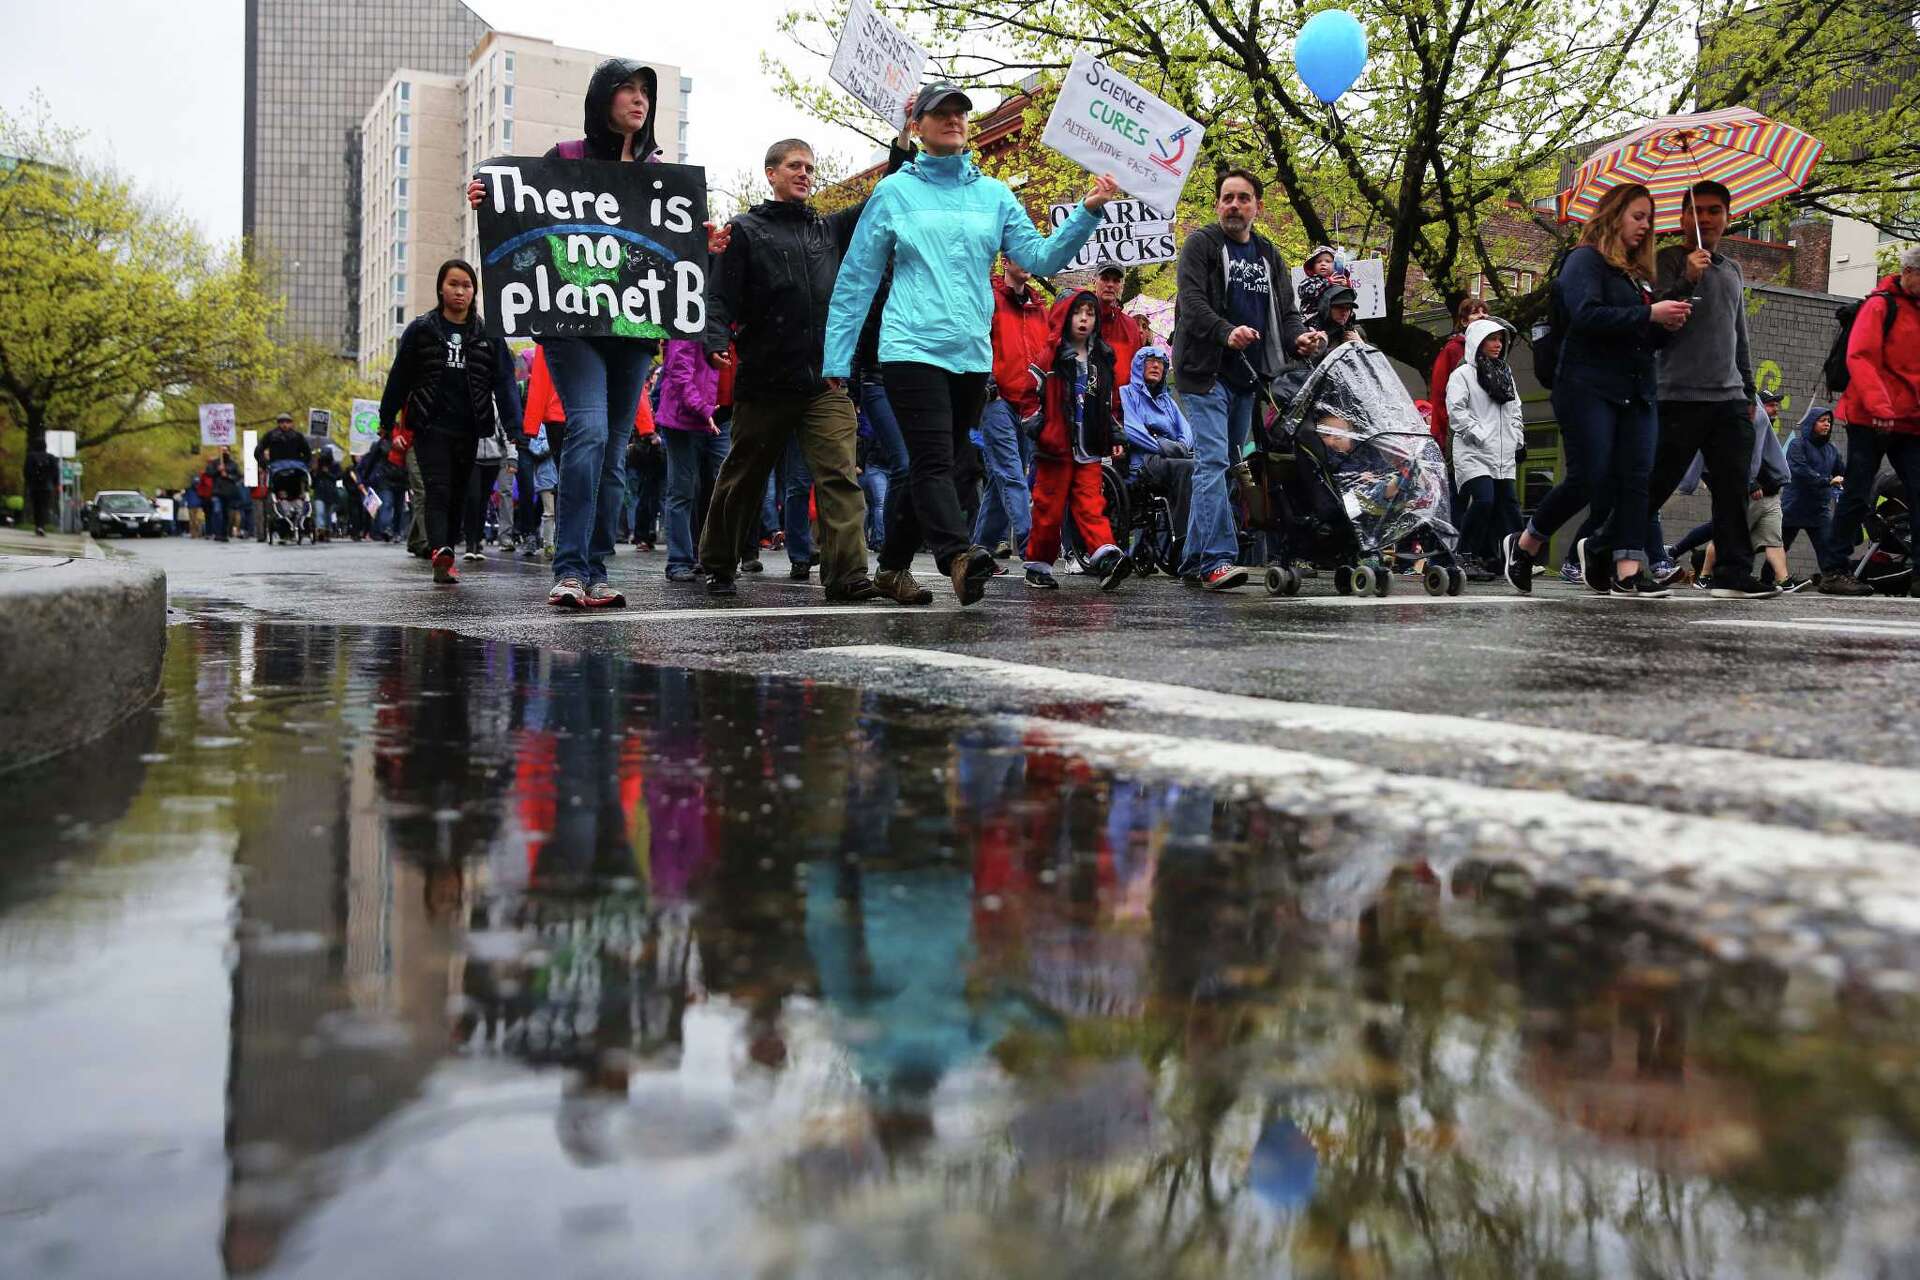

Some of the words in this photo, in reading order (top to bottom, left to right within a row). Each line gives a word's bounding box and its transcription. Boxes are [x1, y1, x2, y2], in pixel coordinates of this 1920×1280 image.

[1086, 61, 1146, 114] SCIENCE
[1089, 99, 1151, 146] CURES
[1063, 118, 1124, 160] ALTERNATIVE
[1126, 156, 1160, 184] FACTS
[478, 166, 622, 226] There
[650, 180, 693, 234] is
[567, 233, 621, 269] no
[1063, 234, 1176, 271] UACKS
[1095, 221, 1133, 243] not
[501, 264, 667, 335] planet
[673, 261, 706, 334] B
